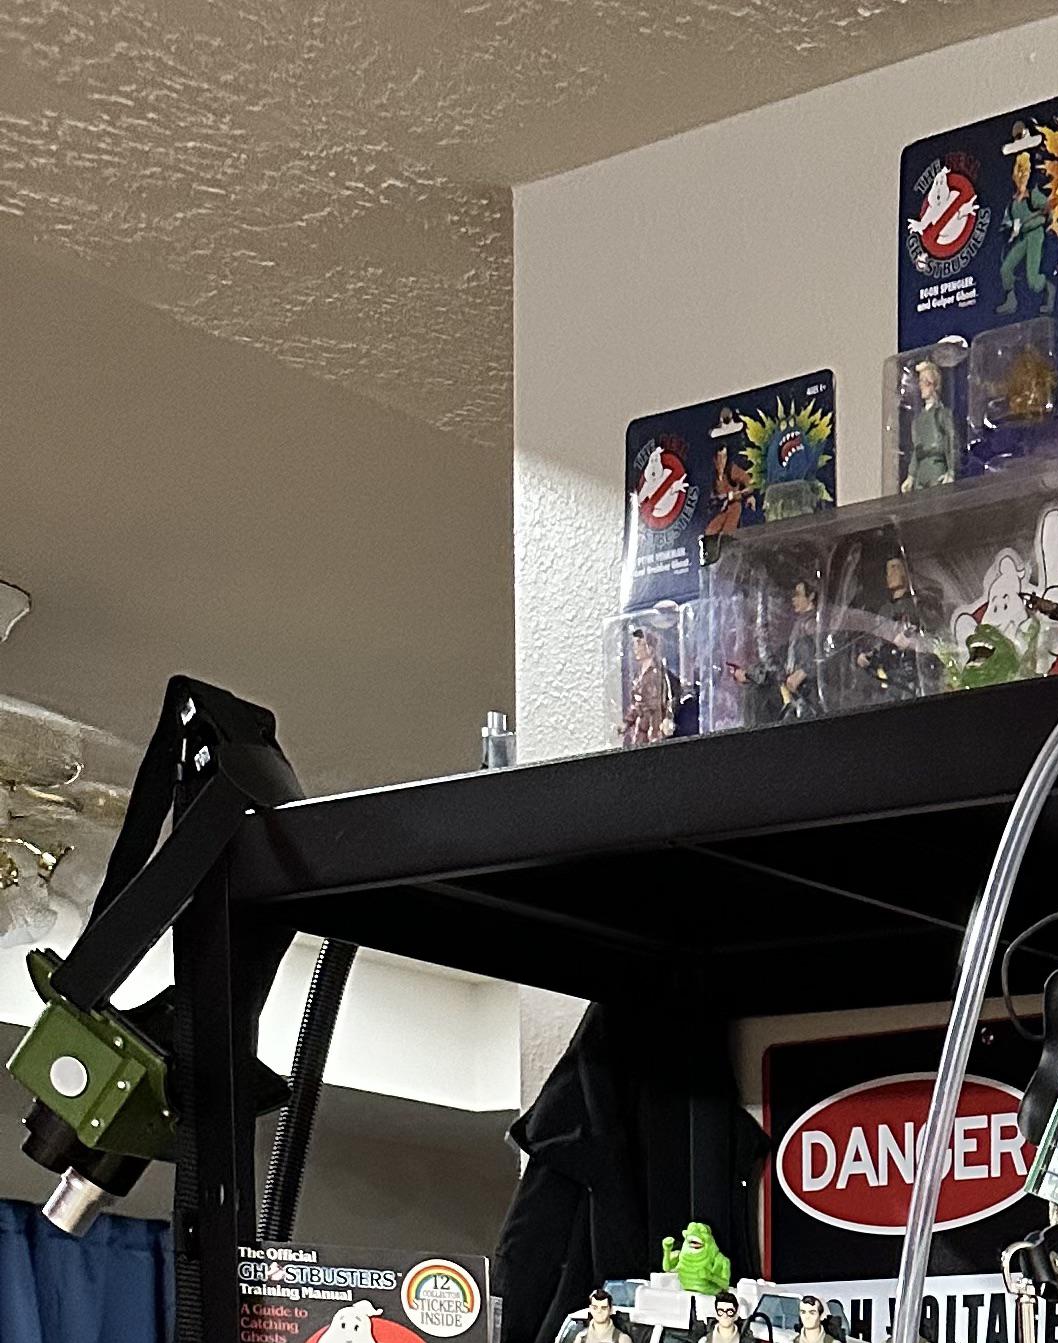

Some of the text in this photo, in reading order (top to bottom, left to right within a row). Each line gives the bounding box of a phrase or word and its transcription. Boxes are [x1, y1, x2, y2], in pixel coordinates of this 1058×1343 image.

[238, 1246, 318, 1263] The Official
[238, 1261, 397, 1290] GHOSTBUSTERS
[431, 1274, 451, 1291] 12
[239, 1283, 353, 1302] Training Manual
[240, 1303, 309, 1318] A Guide to
[413, 1297, 471, 1315] STICKERS
[240, 1317, 299, 1334] Catching
[420, 1312, 463, 1328] INSIDE
